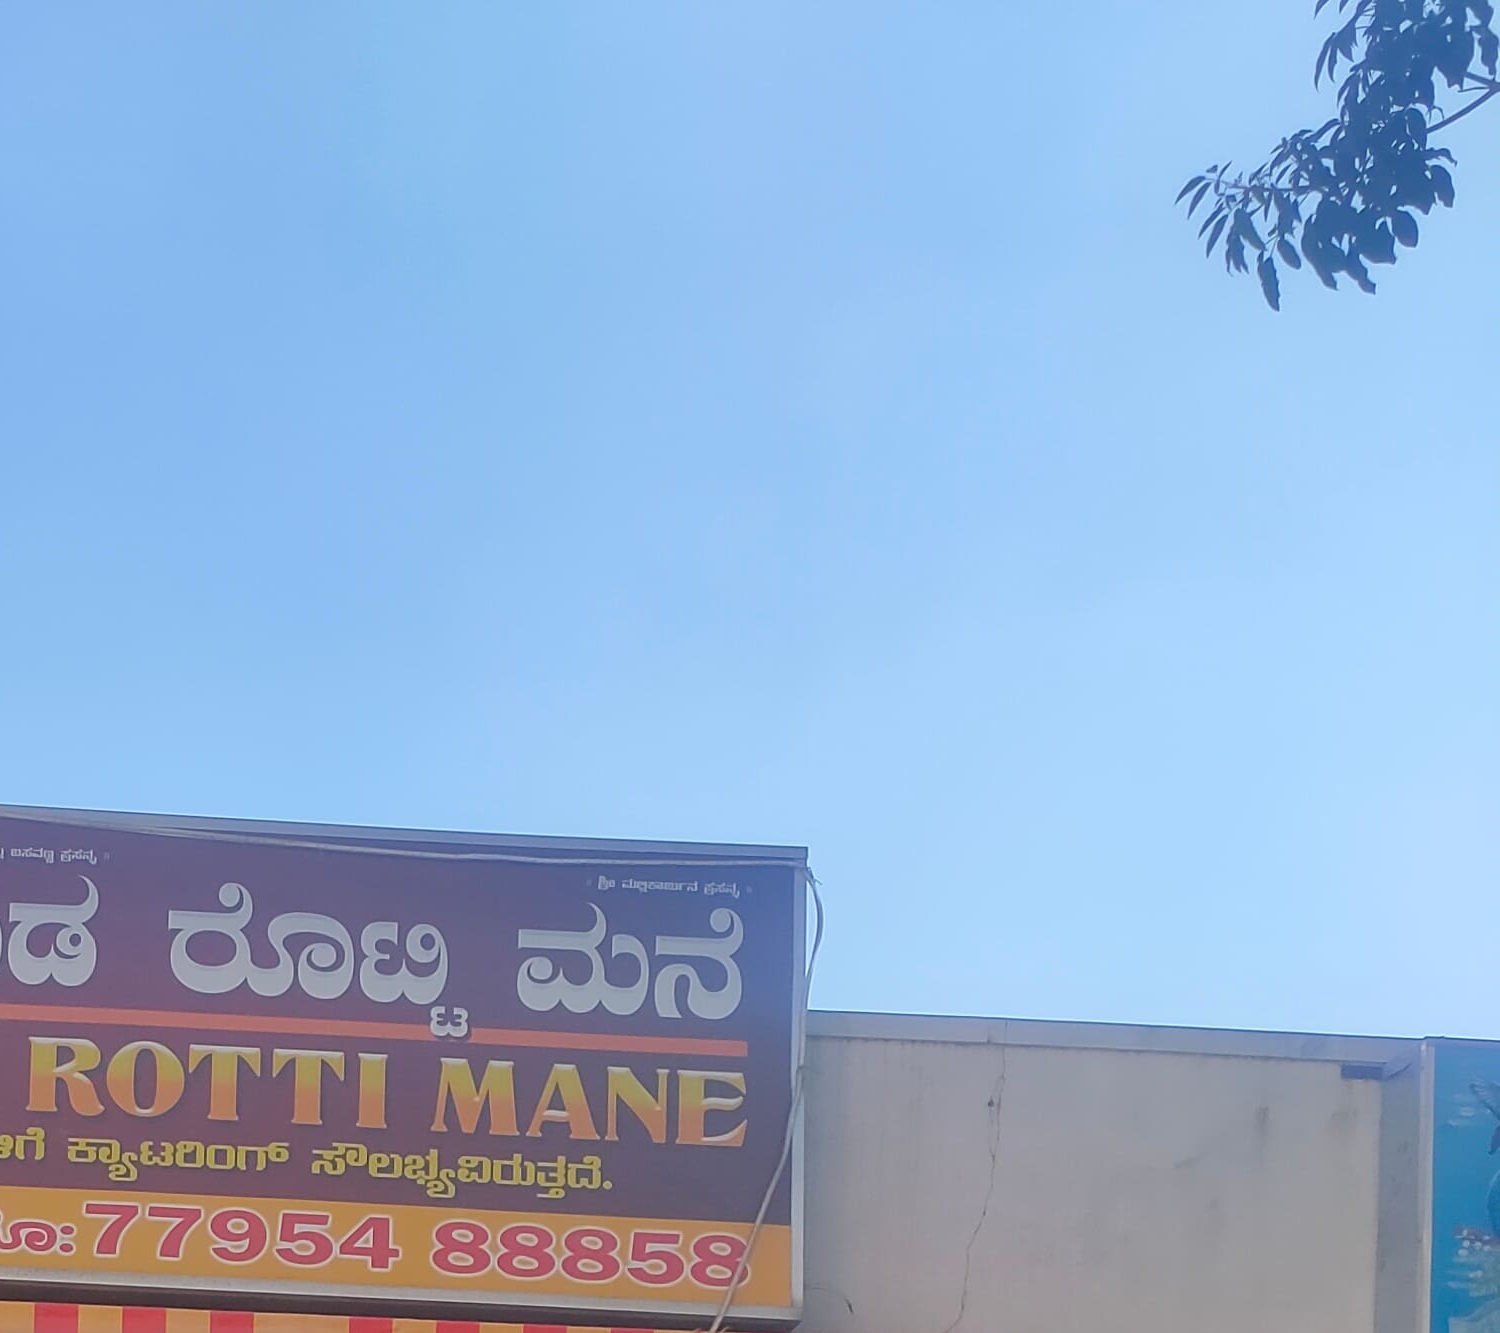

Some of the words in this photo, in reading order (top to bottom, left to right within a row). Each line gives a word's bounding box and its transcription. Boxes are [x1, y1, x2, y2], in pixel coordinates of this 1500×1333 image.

[168, 882, 469, 1038] ರೊಟ್ಟಿ
[516, 902, 745, 1020] ಮನೆ
[25, 1036, 389, 1131] ROTTI
[430, 1056, 749, 1148] MANE
[67, 1137, 290, 1182] ಕ್ಯಾಟರಿಂಗ್
[431, 1218, 751, 1289] 88858
